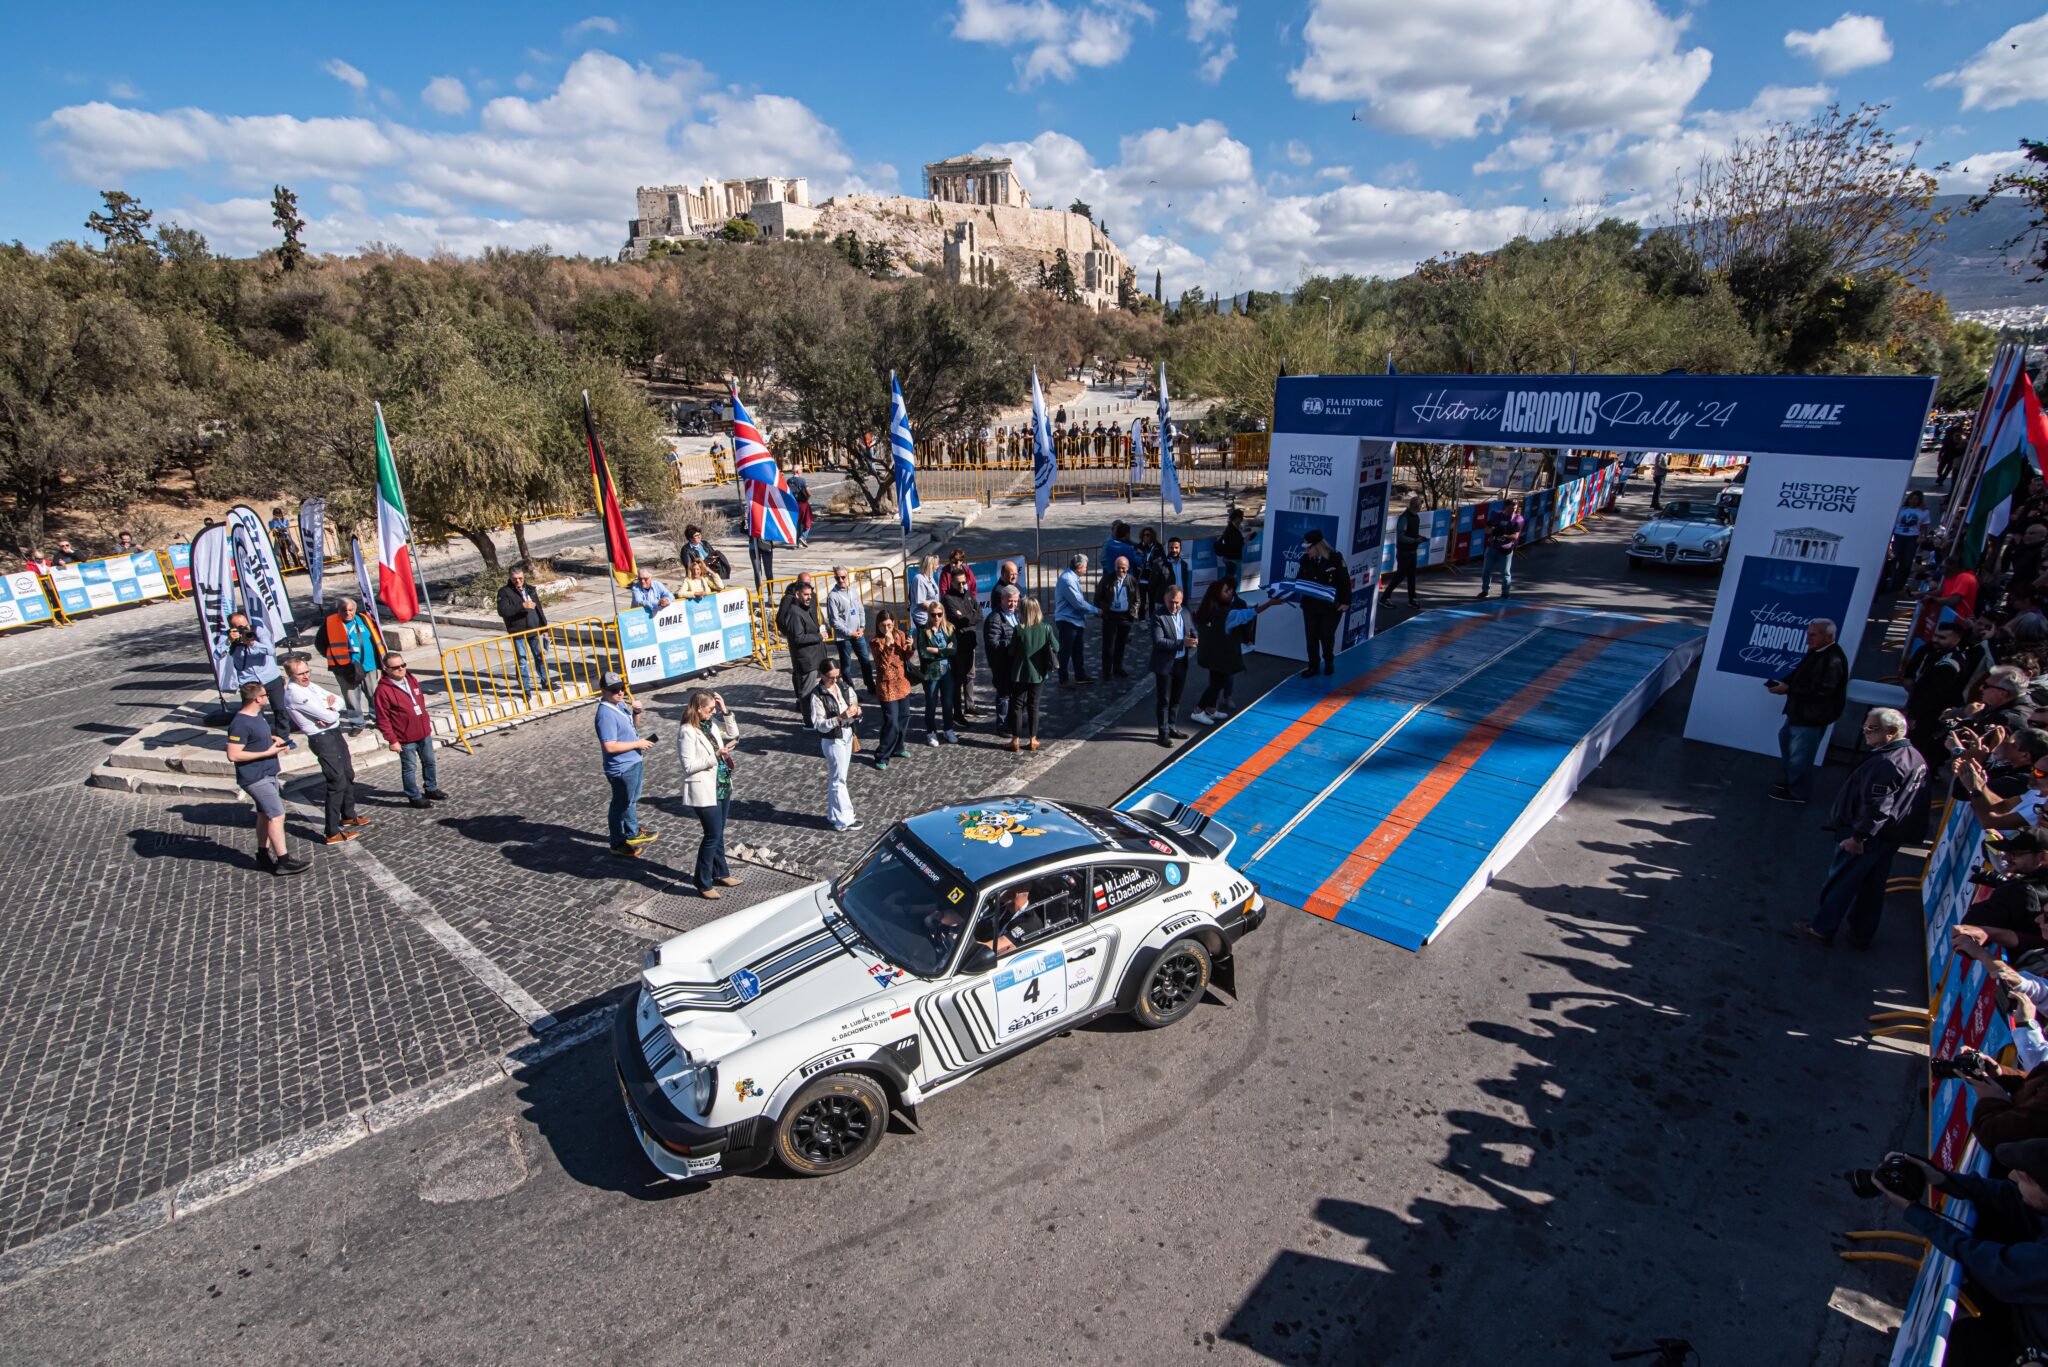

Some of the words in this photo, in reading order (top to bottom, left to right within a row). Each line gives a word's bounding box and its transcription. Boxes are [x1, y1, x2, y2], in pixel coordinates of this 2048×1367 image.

[1326, 398, 1339, 407] FIA
[1341, 398, 1383, 408] HISTORIC
[1325, 406, 1352, 416] RALLY
[1412, 389, 1502, 424] Historic
[1500, 391, 1601, 435] ACROPOLIS
[1785, 403, 1845, 420] OMAE
[1289, 460, 1332, 470] CULTURE
[1290, 454, 1333, 463] HISTORY
[1289, 466, 1332, 477] ACTION
[1781, 481, 1860, 495] HISTORY
[1779, 490, 1857, 504] CULTURE
[1776, 498, 1855, 513] ACTION
[723, 600, 745, 614] OMAE
[659, 613, 683, 627] OMAE
[698, 639, 720, 654] OMAE
[631, 655, 657, 668] OMAE
[1169, 867, 1177, 879] 3
[1104, 868, 1141, 894] M.Lubiak
[1108, 873, 1157, 906] G.Dachowski
[1161, 914, 1201, 936] PIRELLI
[1023, 977, 1040, 1004] 4
[850, 1016, 870, 1027] LUBIAK
[1007, 1006, 1059, 1034] SEAJETS
[839, 1023, 873, 1040] DACHOWSKI
[799, 1047, 856, 1079] PIRELLI
[687, 1160, 716, 1168] SPEED
